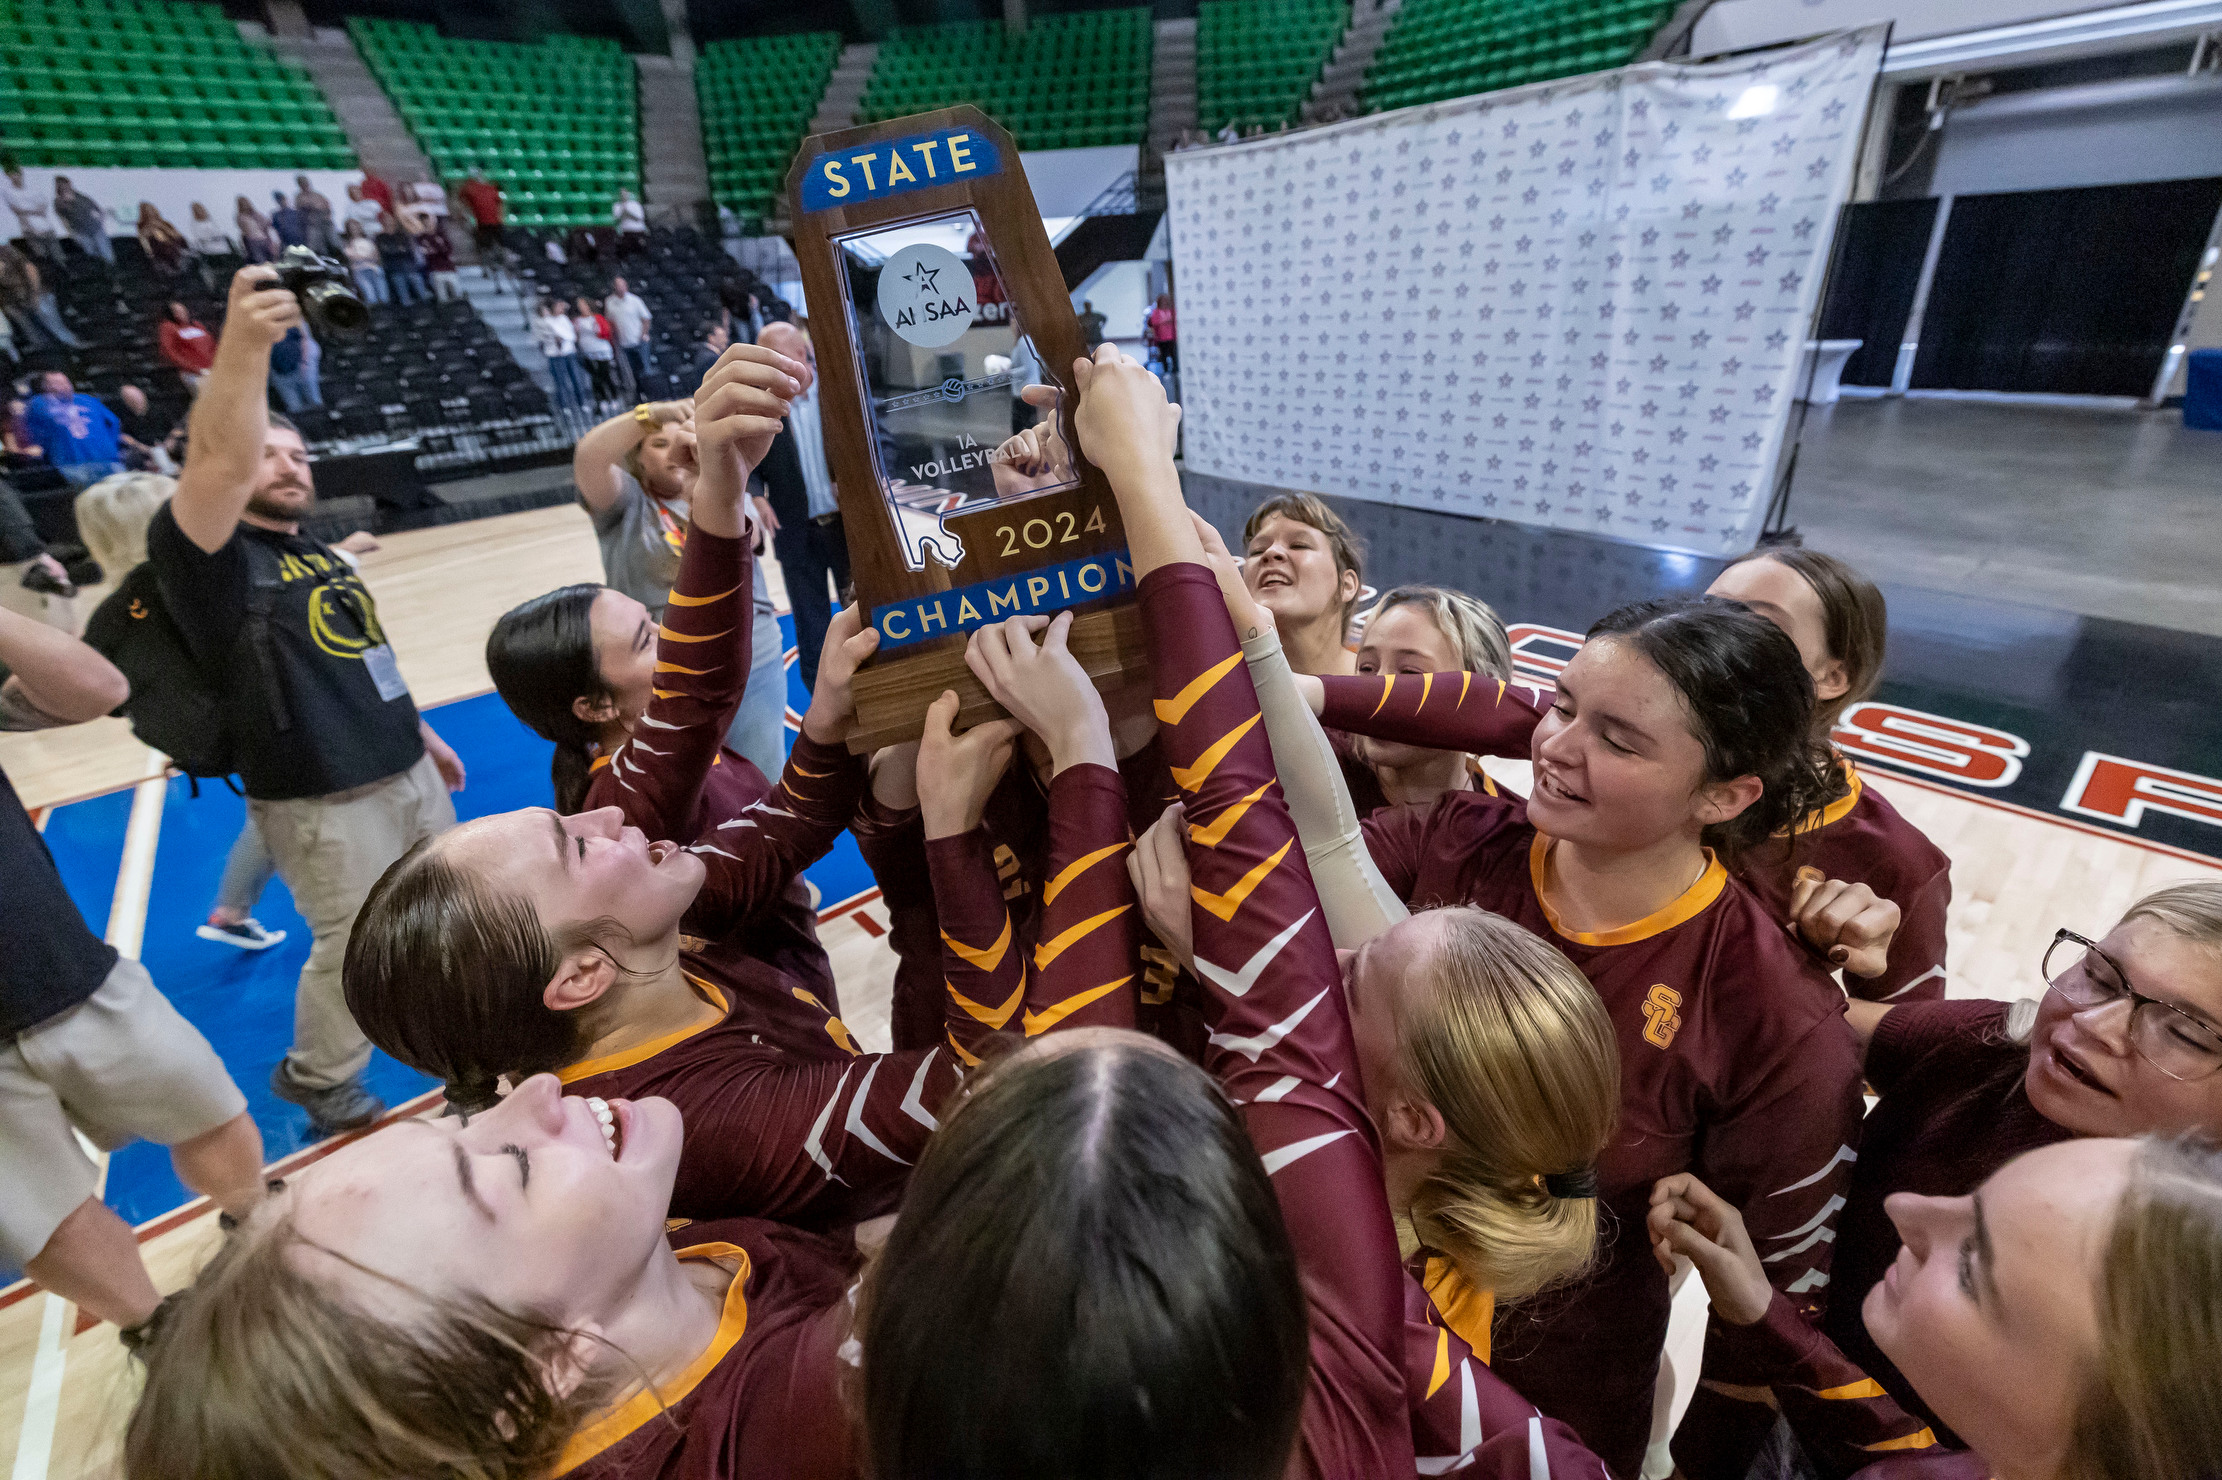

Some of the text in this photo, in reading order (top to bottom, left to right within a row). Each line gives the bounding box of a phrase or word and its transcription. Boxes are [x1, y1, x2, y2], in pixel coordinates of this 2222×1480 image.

[823, 133, 977, 198] STATE
[955, 432, 978, 450] 1A
[995, 504, 1107, 557] 2024
